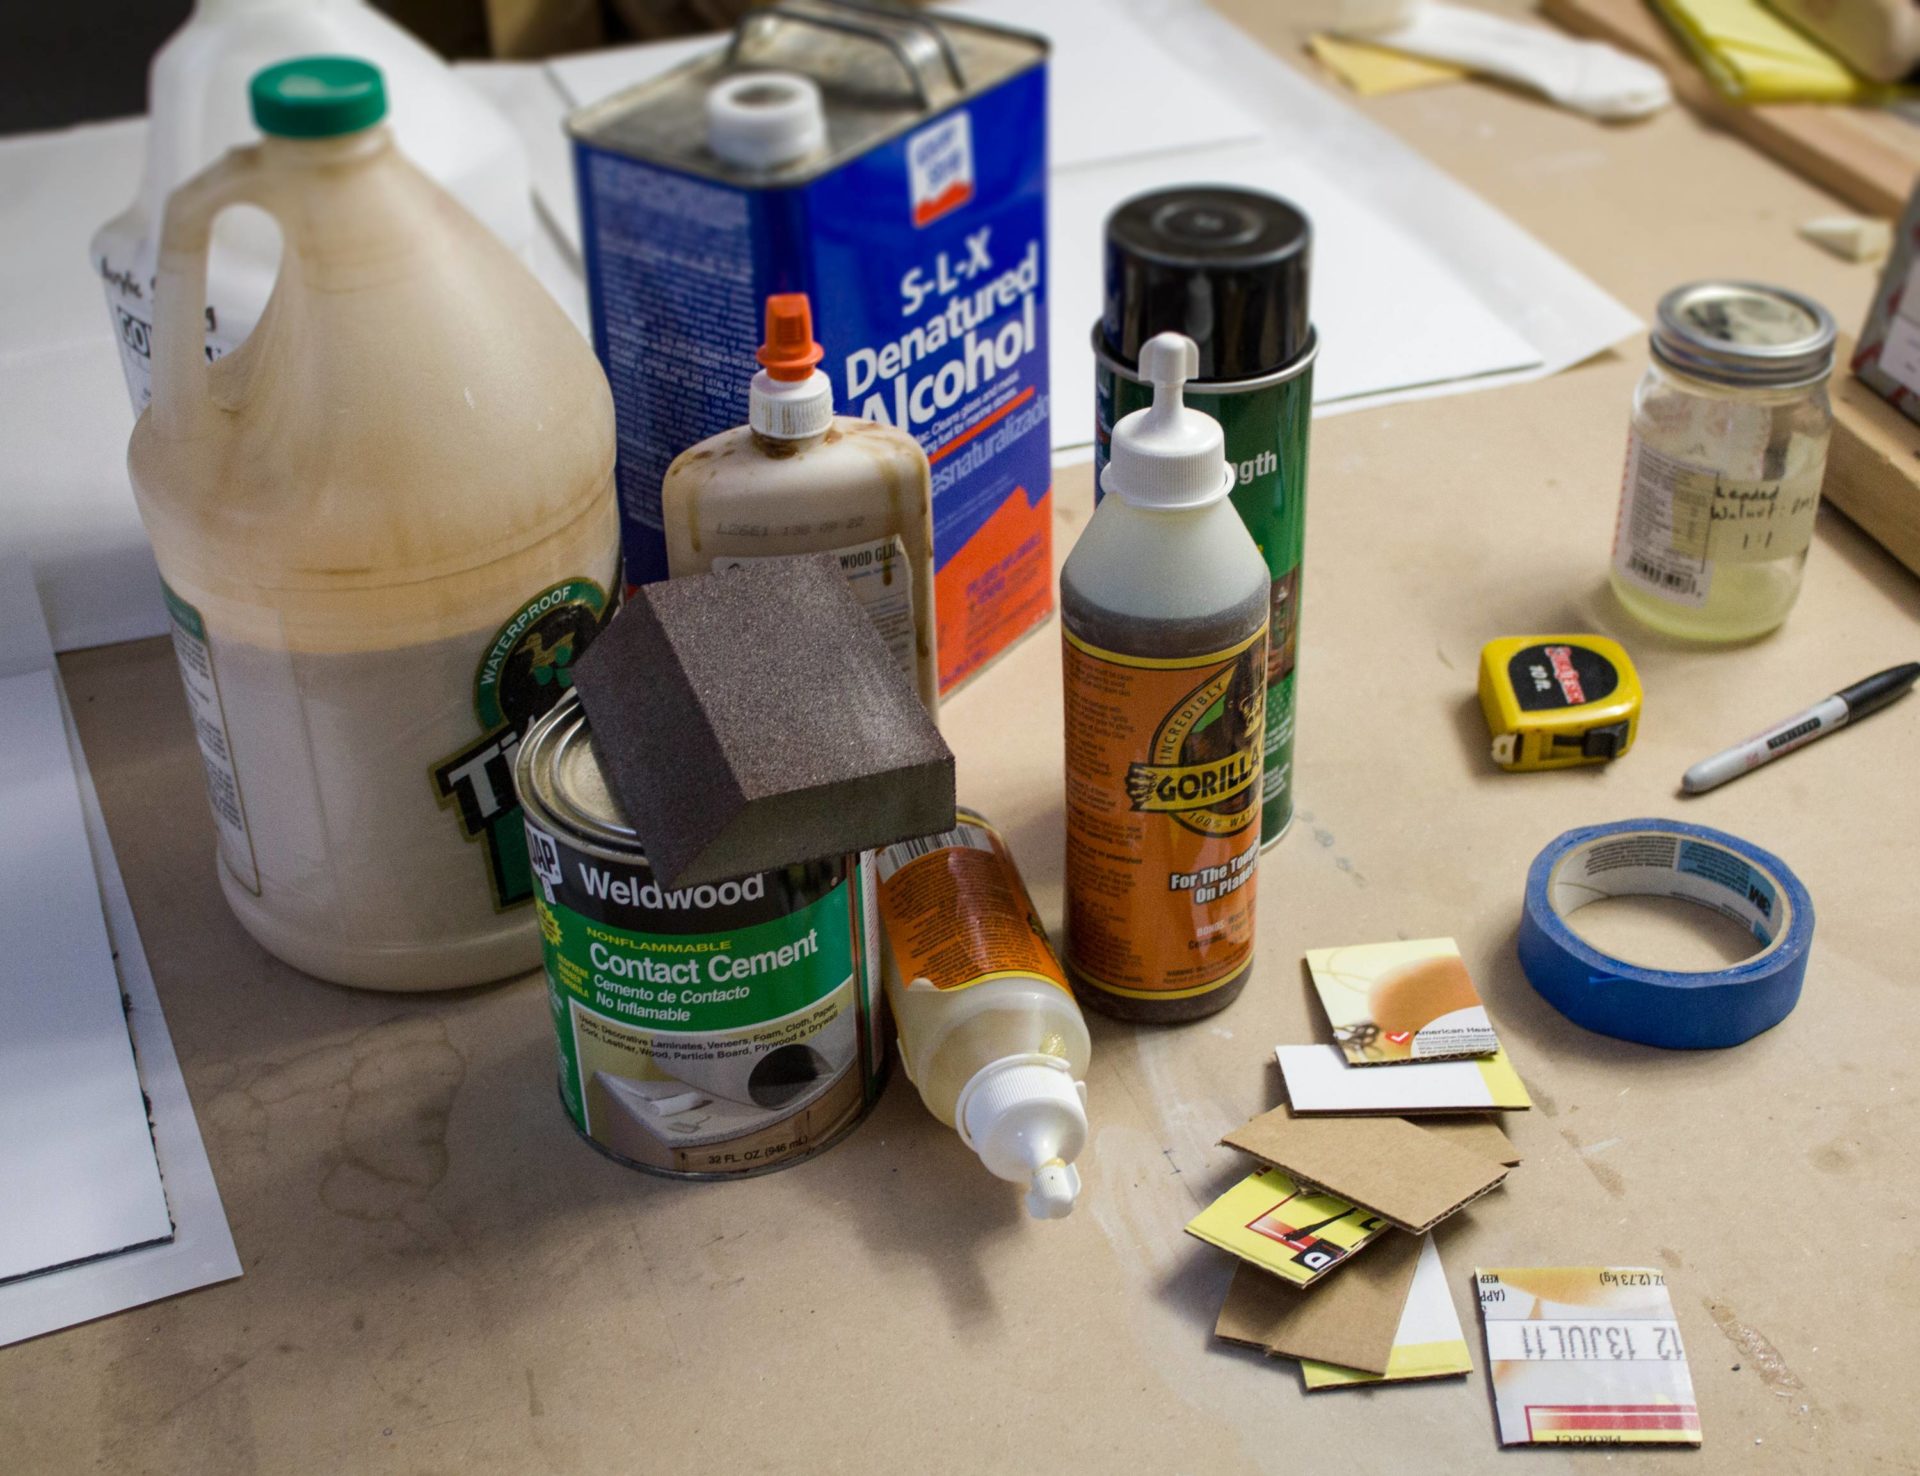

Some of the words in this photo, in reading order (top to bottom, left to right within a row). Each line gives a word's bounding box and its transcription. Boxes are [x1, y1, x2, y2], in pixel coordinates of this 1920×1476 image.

[902, 226, 992, 317] S-L-X
[846, 238, 1039, 400] Denatured
[861, 289, 1036, 433] Alcohol
[932, 393, 1050, 497] esnaturalizado
[839, 551, 872, 571] WOOD
[481, 586, 571, 686] WATERPROOF
[1159, 681, 1223, 761] INCREDIBLY
[1156, 748, 1260, 802] GORILLA
[1188, 811, 1221, 828] 100%
[578, 862, 766, 911] Weldwood
[1171, 873, 1198, 890] For
[1201, 865, 1228, 885] The
[1196, 887, 1216, 904] On
[586, 925, 733, 954] NONFLAMMABLE
[590, 941, 701, 985] Contact
[707, 928, 820, 983] Cement
[593, 973, 654, 1005] Cemento
[657, 985, 678, 1005] de
[680, 984, 750, 1005] Contacto
[596, 990, 614, 1010] No
[616, 998, 691, 1022] Inflamable
[601, 1024, 648, 1046] Decorative
[650, 1039, 707, 1051] Laminates,
[707, 1037, 752, 1050] Veneers,
[753, 1029, 784, 1042] Foam,
[785, 1018, 812, 1033] Cloth,
[603, 1036, 639, 1055] Leather,
[640, 1048, 671, 1061] Wood,
[674, 1051, 713, 1061] Particle
[717, 1047, 752, 1059] Board,
[755, 1033, 798, 1053] Plywood
[799, 1029, 807, 1039] &
[808, 1009, 838, 1034] Drywall
[1415, 1028, 1464, 1037] American
[708, 1154, 722, 1165] 32
[1479, 1273, 1500, 1284] KEEP
[1599, 1271, 1620, 1288] kg)
[1621, 1272, 1652, 1288] (2.73
[1521, 1325, 1636, 1361] 13JUL11
[1652, 1326, 1684, 1361] 12
